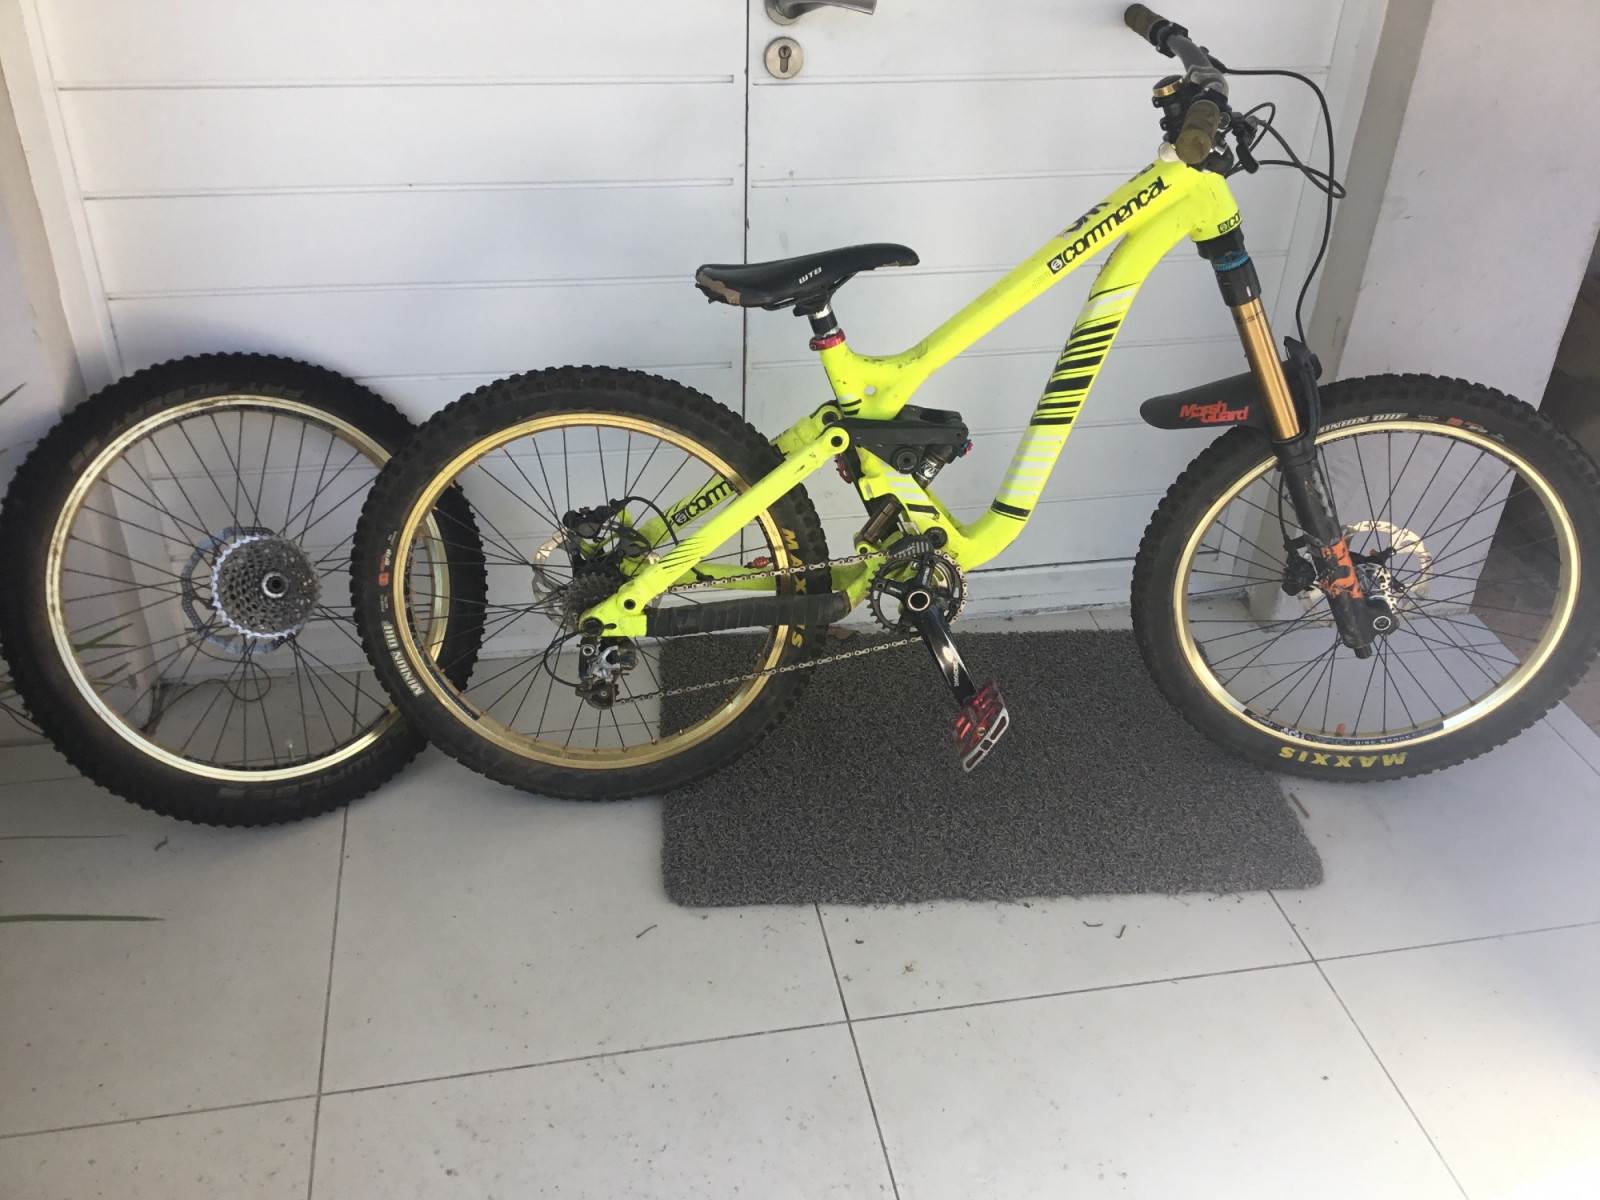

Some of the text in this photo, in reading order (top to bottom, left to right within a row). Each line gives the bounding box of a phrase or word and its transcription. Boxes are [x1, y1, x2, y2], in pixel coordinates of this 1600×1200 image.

[1063, 176, 1172, 264] commencal
[798, 266, 823, 285] WTB
[1201, 405, 1250, 423] Guard
[391, 650, 425, 698] MINION
[1278, 747, 1408, 768] MAXXIS
